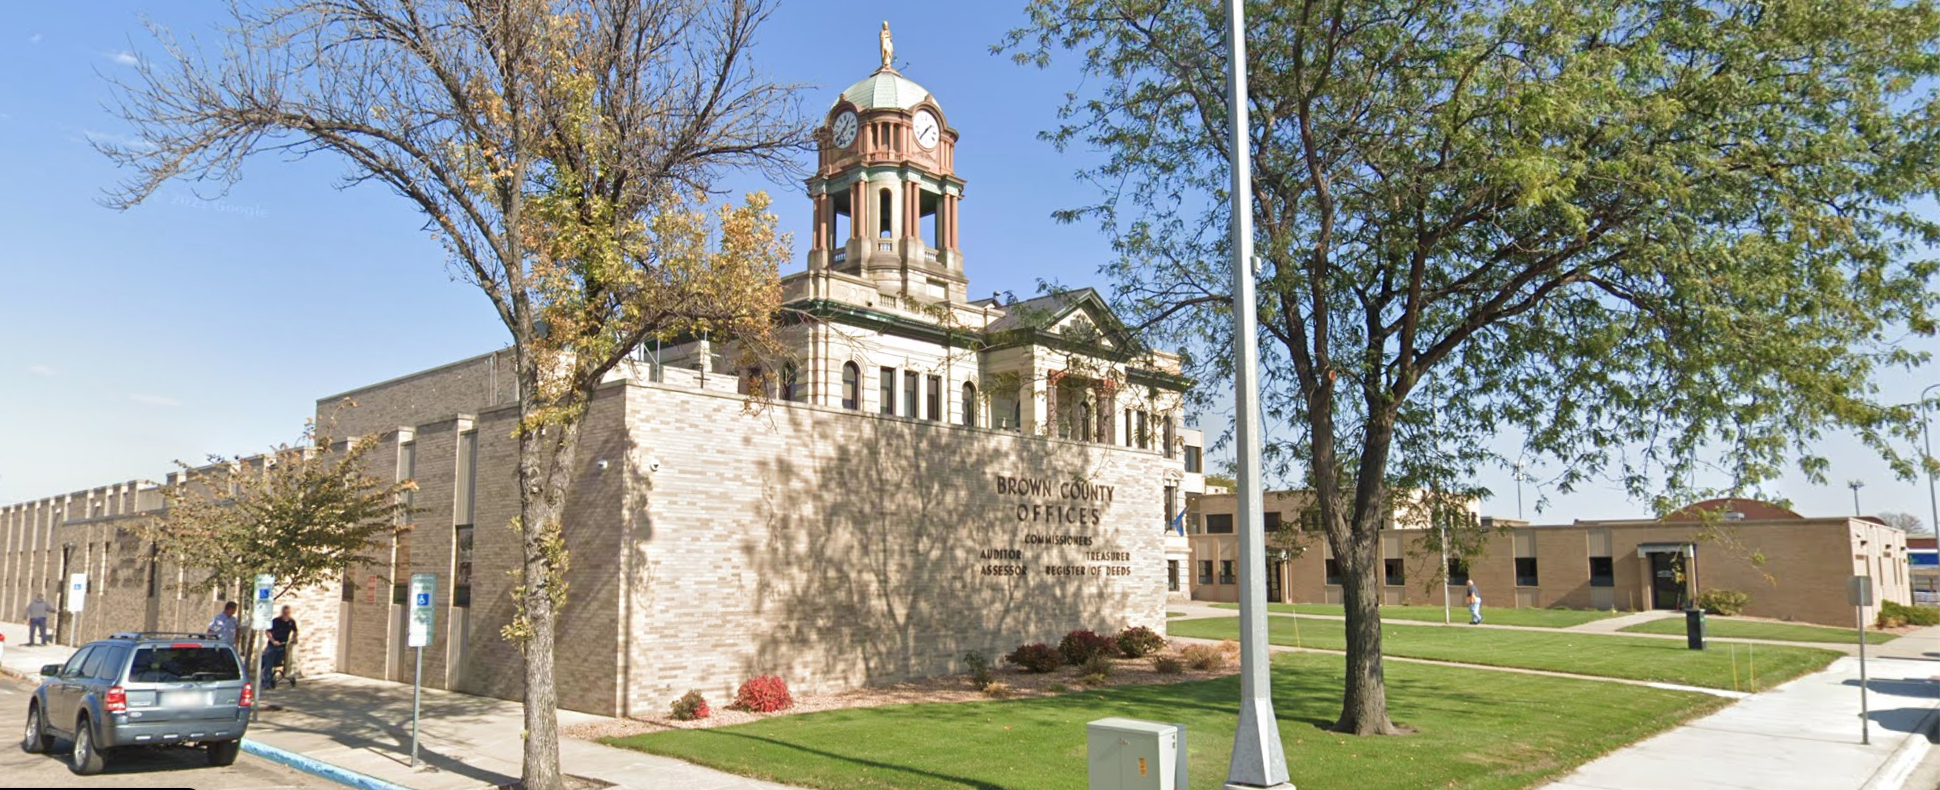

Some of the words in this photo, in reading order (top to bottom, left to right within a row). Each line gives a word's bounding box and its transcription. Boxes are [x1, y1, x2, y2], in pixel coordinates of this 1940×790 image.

[997, 476, 1051, 497] BROWN
[1060, 482, 1115, 502] COUNTY
[1017, 504, 1100, 525] OFFICES
[1025, 534, 1093, 546] COMMISSIONERS
[980, 549, 1022, 560] AUDITOR
[1086, 551, 1130, 562] TREASURER
[980, 565, 1027, 576] ASSESSOR
[1046, 566, 1086, 576] REGISTER
[1090, 566, 1102, 576] OF
[1106, 566, 1131, 576] DEEDS
